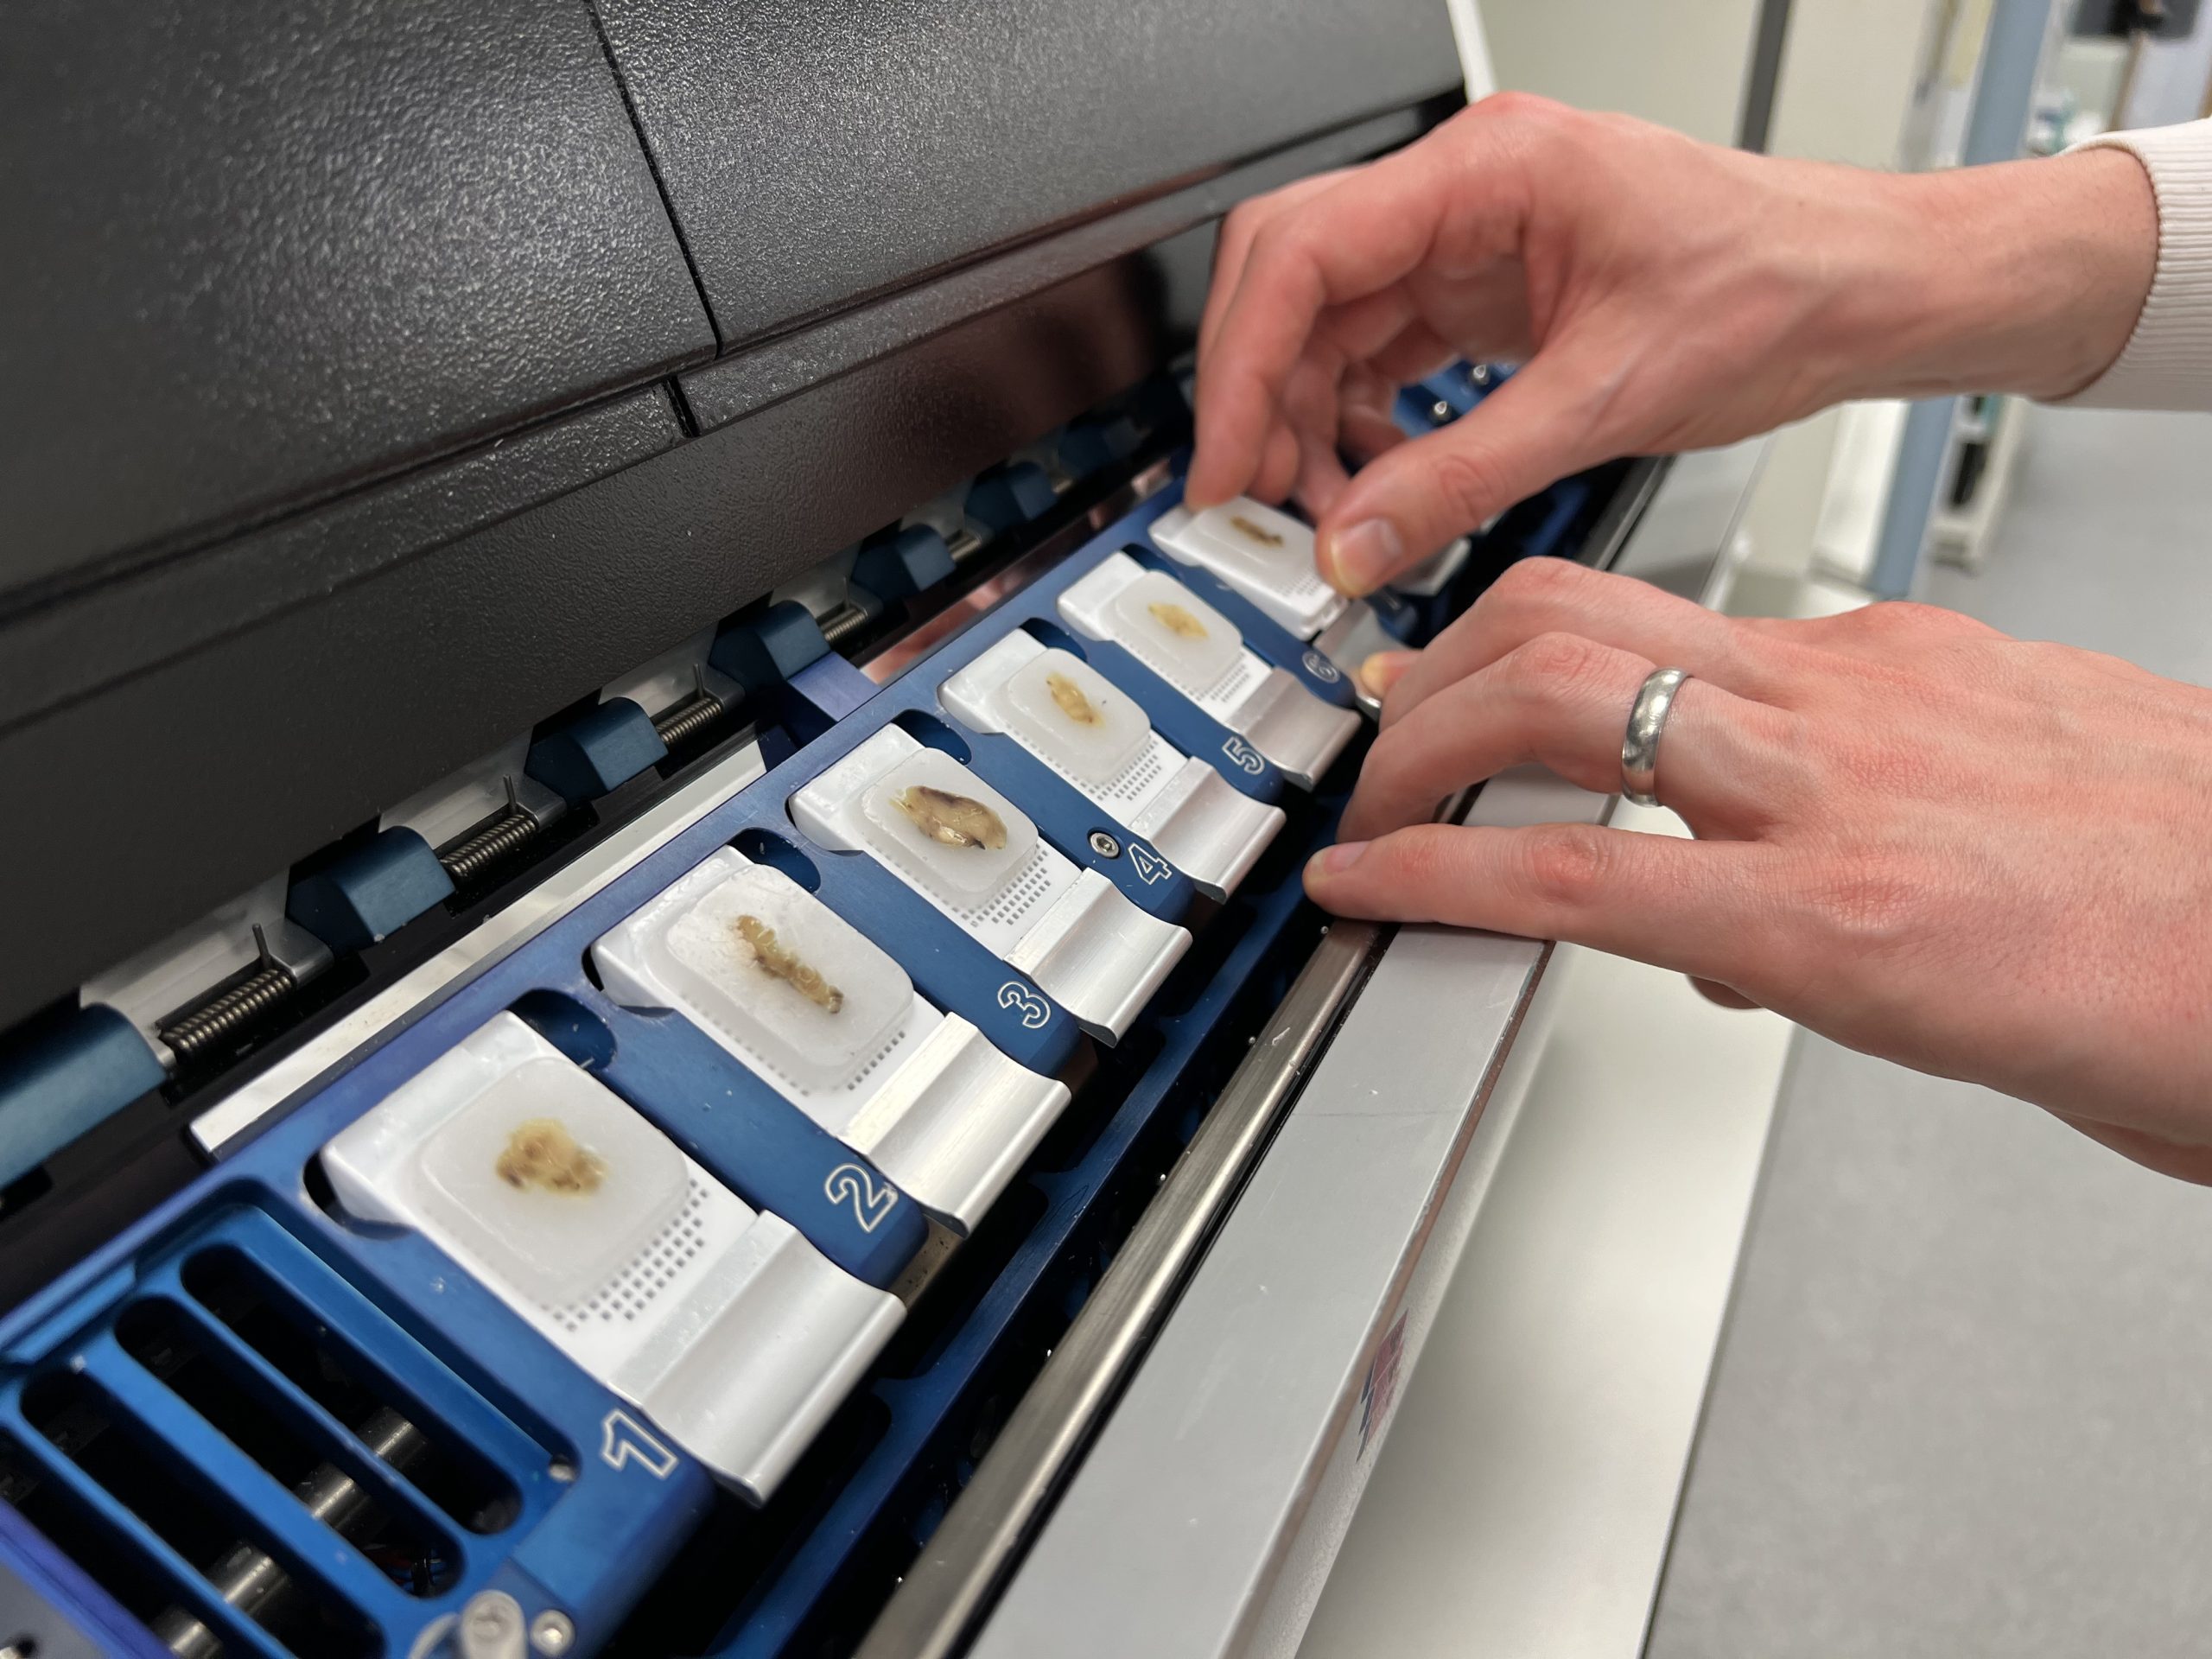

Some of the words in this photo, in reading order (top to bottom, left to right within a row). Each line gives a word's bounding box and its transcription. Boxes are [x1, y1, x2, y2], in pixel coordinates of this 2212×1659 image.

[1302, 652, 1339, 683] 6
[1222, 736, 1265, 775] 5
[1128, 842, 1173, 885] 4
[997, 982, 1051, 1028] 3
[825, 1163, 899, 1233] 2
[601, 1408, 679, 1479] 1
